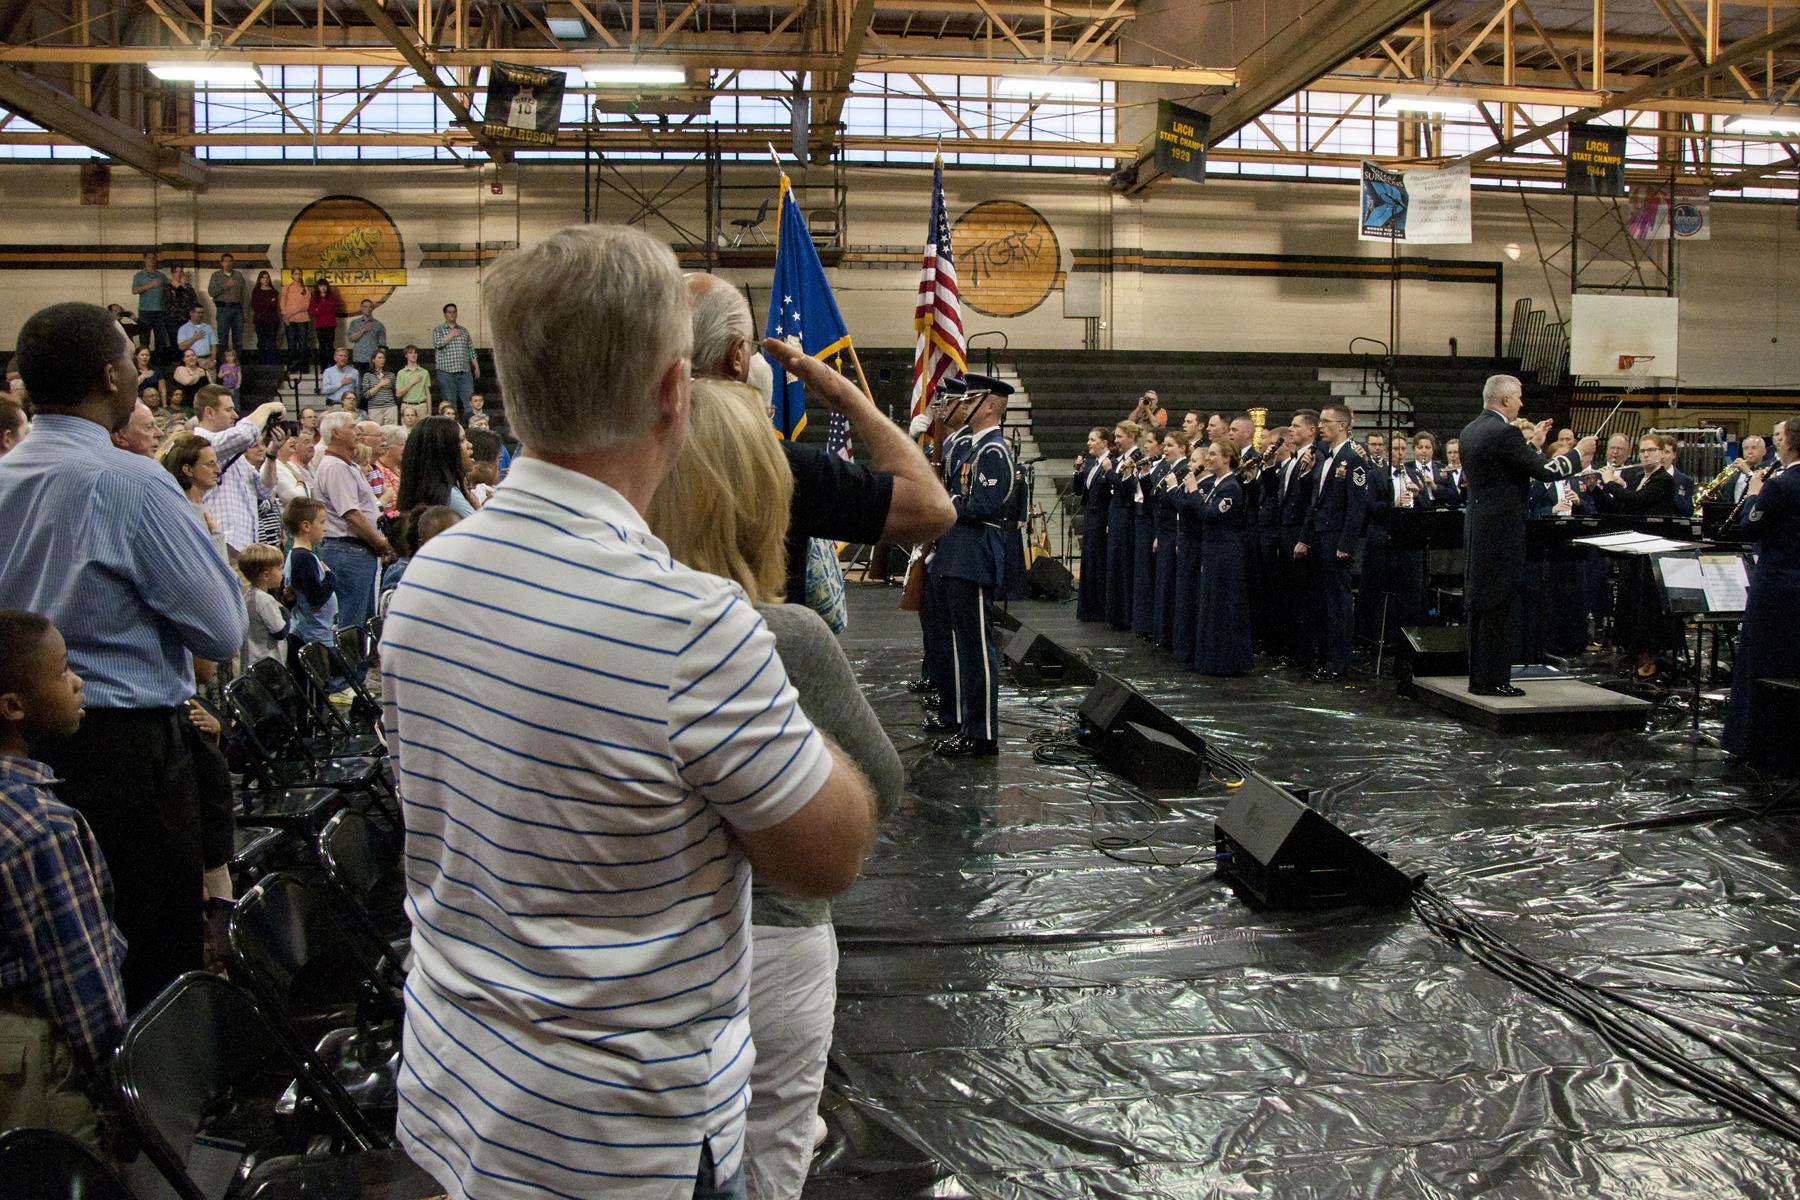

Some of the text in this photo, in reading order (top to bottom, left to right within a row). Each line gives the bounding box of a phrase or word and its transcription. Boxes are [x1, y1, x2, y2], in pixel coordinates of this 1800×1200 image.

[517, 104, 532, 115] 10
[484, 124, 555, 145] RICHARDSON
[1173, 121, 1194, 138] LRCH
[1160, 131, 1204, 152] STATE CHAMPS
[1586, 140, 1609, 153] LRCH
[1172, 148, 1191, 162] 1929
[1572, 152, 1622, 166] STATE CHAMPS
[959, 220, 1043, 288] TIGERS
